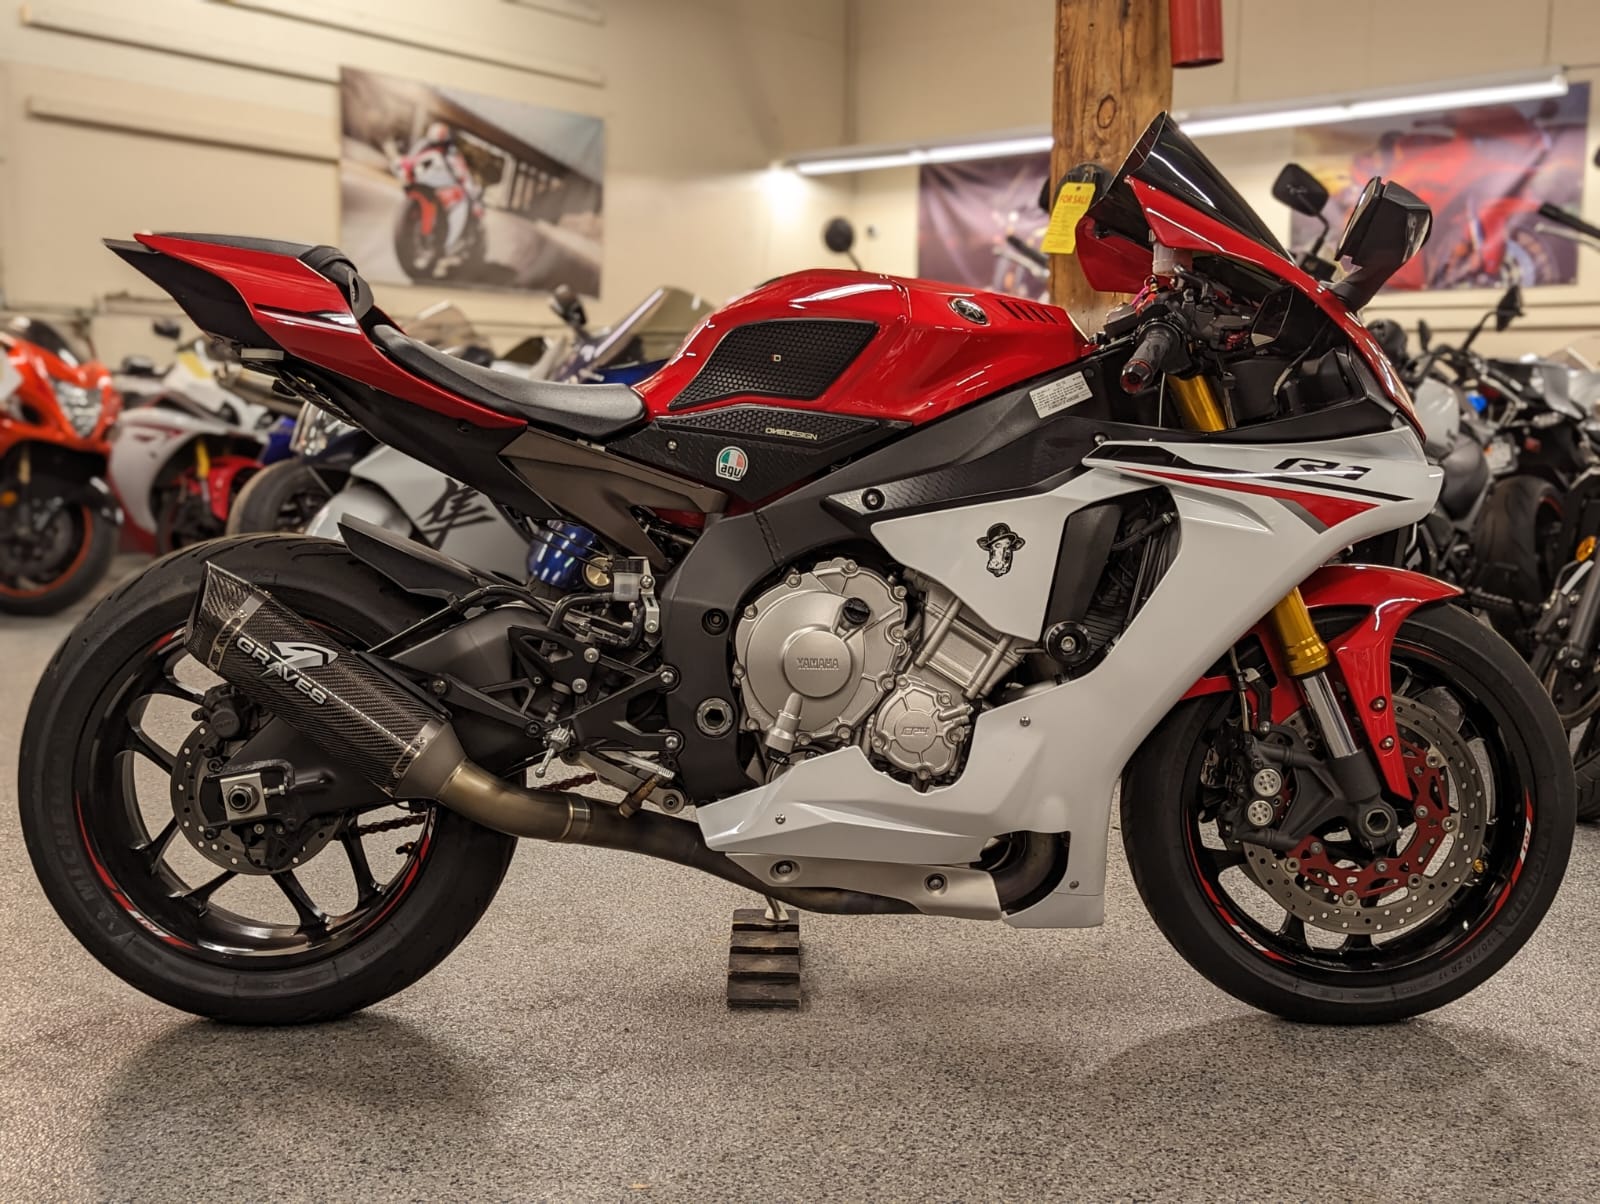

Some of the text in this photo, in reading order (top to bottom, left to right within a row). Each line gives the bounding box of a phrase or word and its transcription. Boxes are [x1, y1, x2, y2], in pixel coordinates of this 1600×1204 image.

[1061, 194, 1090, 205] FOR SALE
[765, 427, 818, 440] ONEDESIGN
[1274, 457, 1371, 480] R1
[797, 657, 839, 670] YAMAHA
[236, 636, 327, 705] GRAVES
